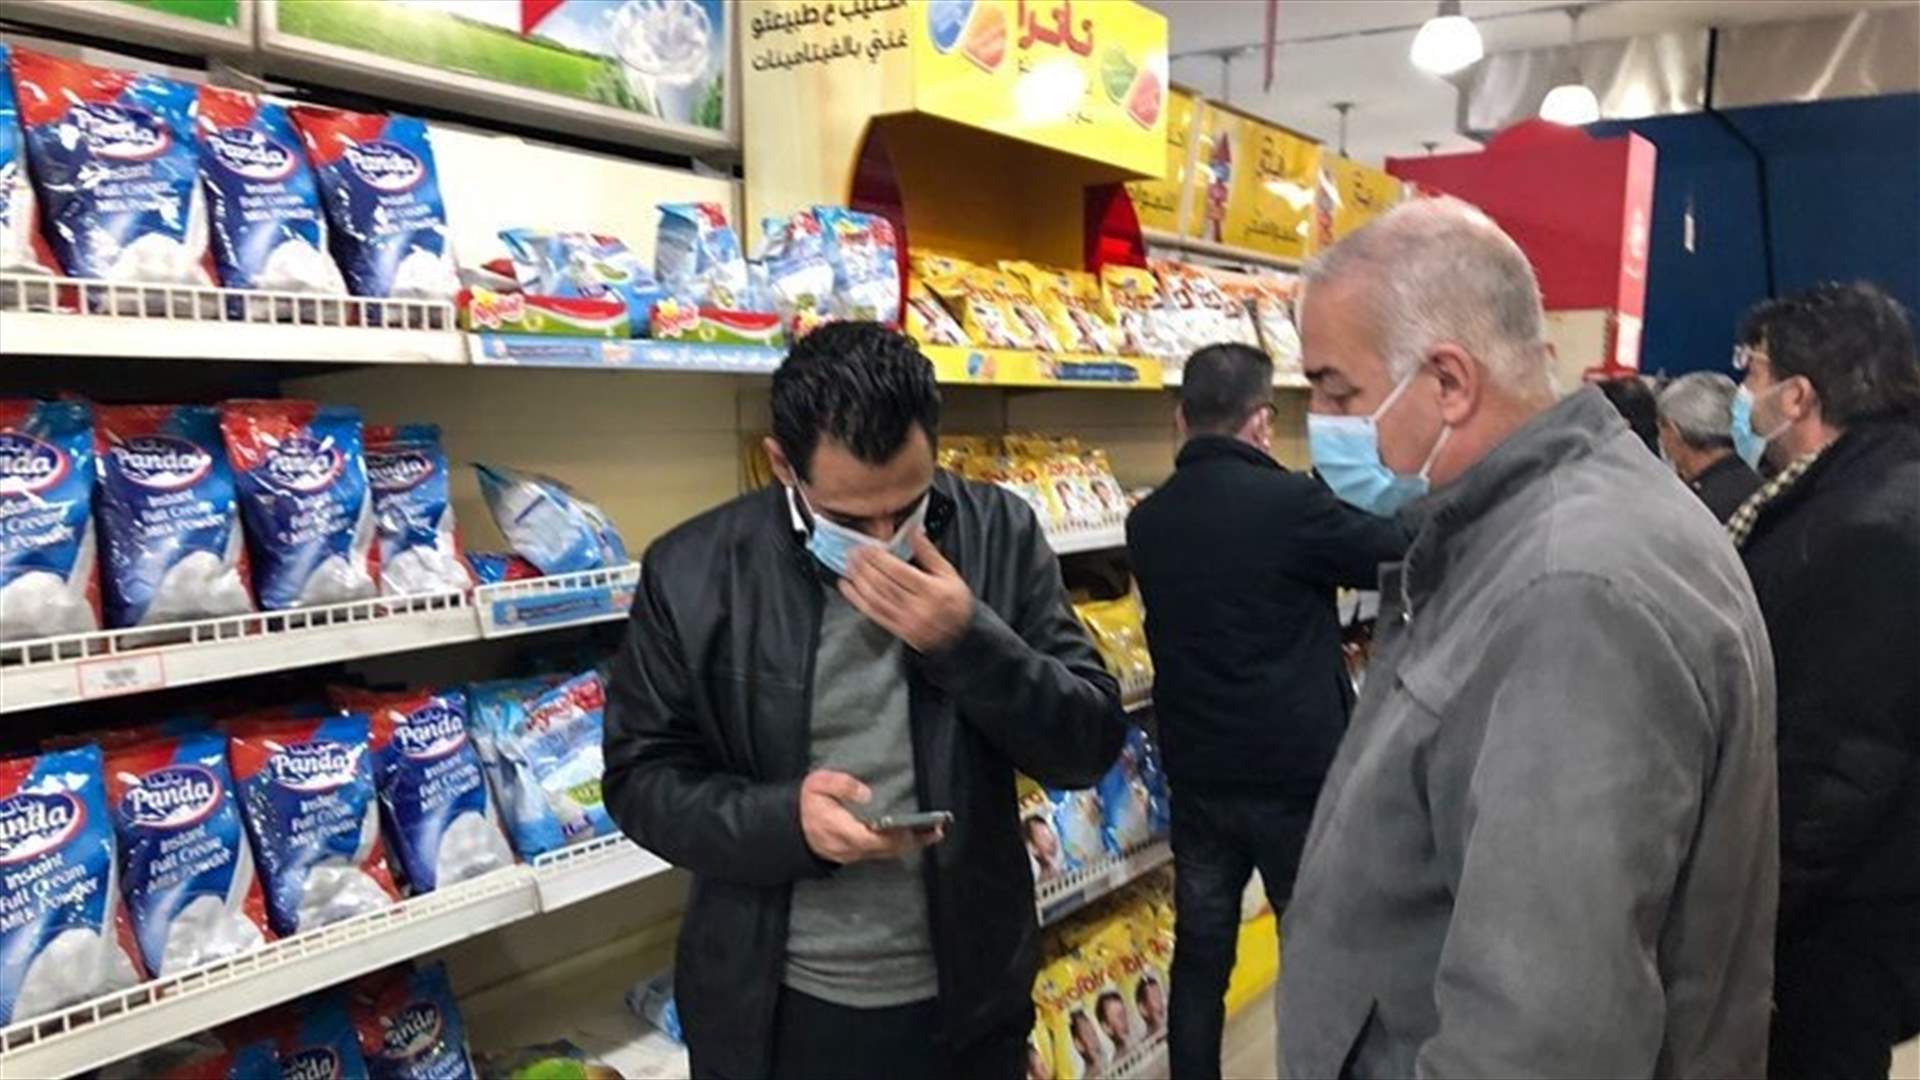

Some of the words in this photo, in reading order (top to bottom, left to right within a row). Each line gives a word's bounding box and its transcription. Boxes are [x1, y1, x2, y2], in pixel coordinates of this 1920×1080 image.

[111, 447, 196, 472] Panda
[393, 713, 463, 745] Panda
[270, 750, 345, 776] Panda
[125, 777, 211, 812] Panda
[4, 852, 64, 891] Instant
[33, 863, 87, 899] Cream
